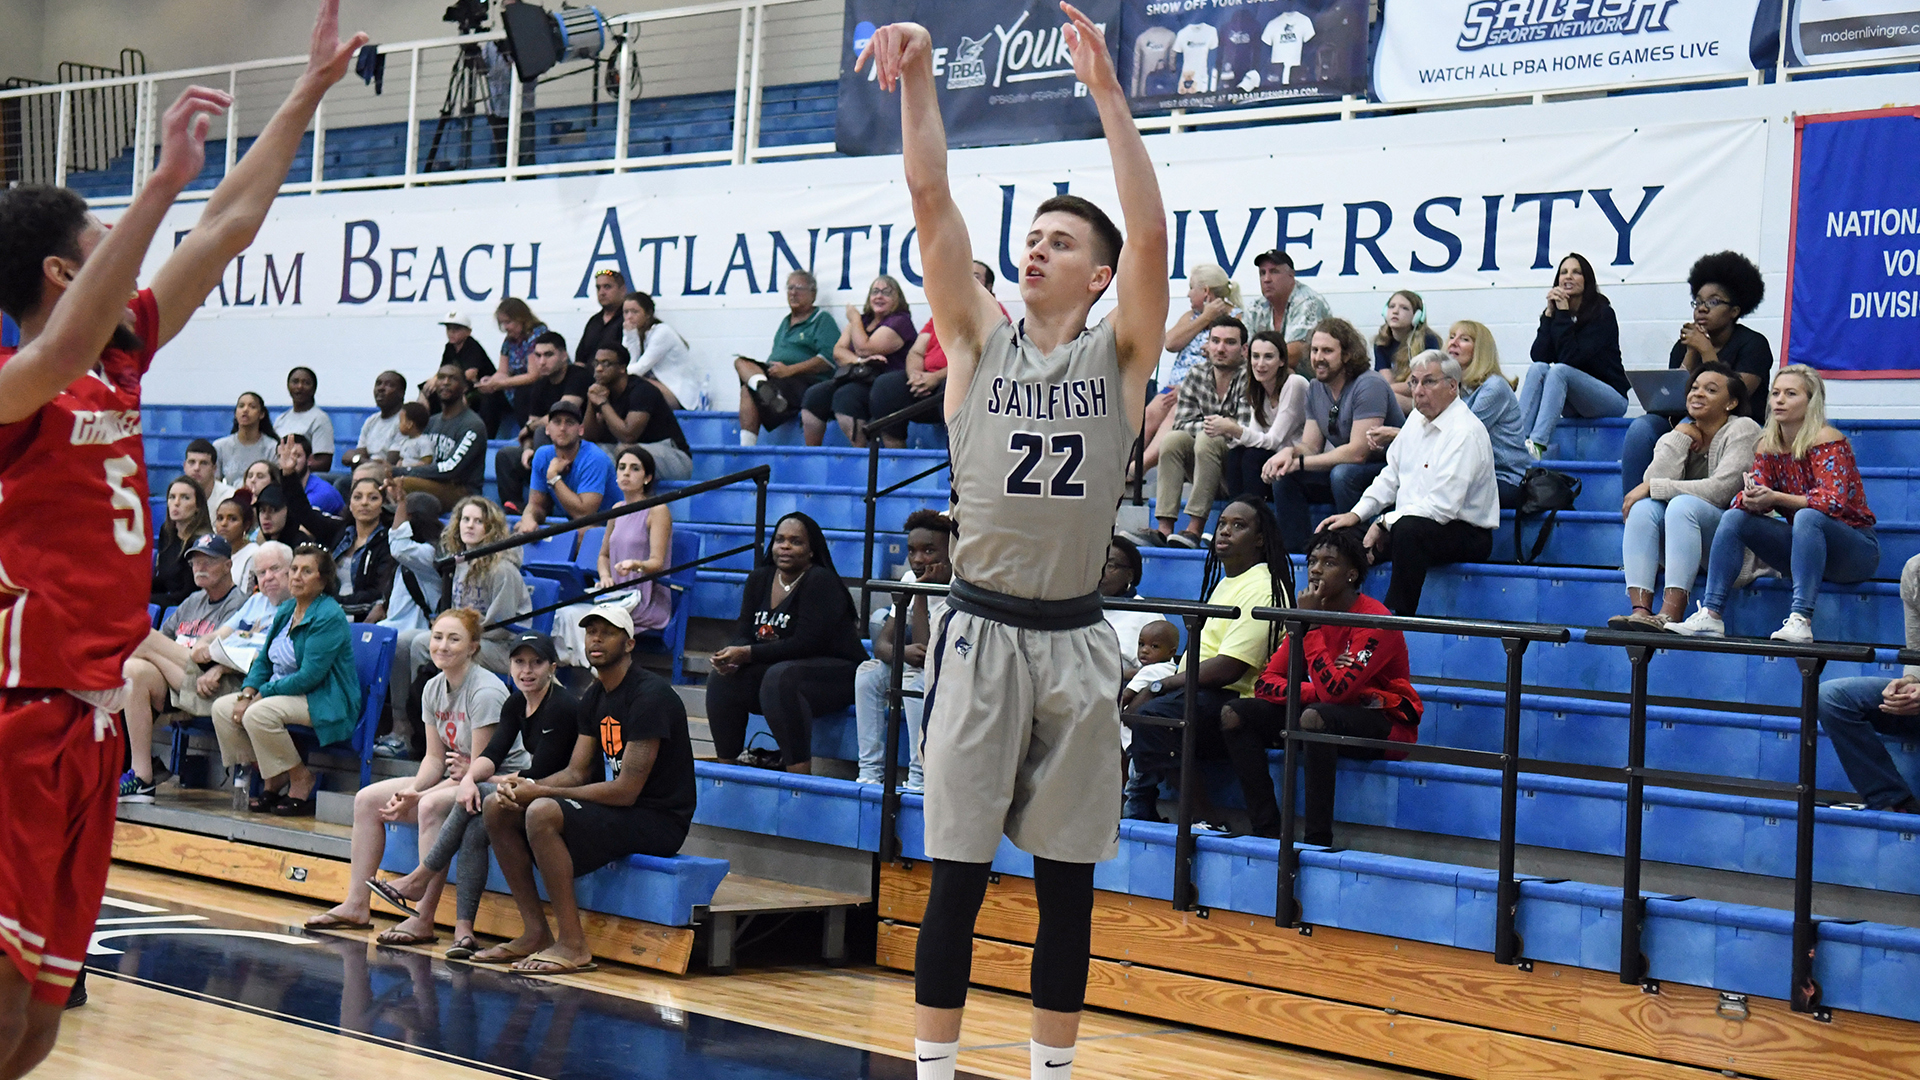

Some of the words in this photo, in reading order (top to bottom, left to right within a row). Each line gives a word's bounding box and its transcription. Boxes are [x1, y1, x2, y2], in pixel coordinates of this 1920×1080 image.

[1146, 3, 1181, 16] SHOW
[1184, 0, 1207, 11] OFF
[1487, 25, 1547, 45] SPORTS
[1549, 15, 1628, 39] NETWORK
[993, 10, 1107, 88] YOUR
[1418, 65, 1475, 84] WATCH
[1479, 62, 1508, 78] ALL
[1512, 58, 1548, 76] PBA
[1552, 52, 1604, 72] HOME
[1608, 45, 1675, 66] GAMES
[1680, 40, 1720, 59] LIVE
[951, 61, 984, 79] PBA
[1190, 96, 1216, 107] ONLINE
[1826, 207, 1920, 238] NATION
[337, 219, 541, 305] BEACH
[999, 181, 1665, 284] UIVERSITY
[1849, 290, 1920, 319] DIVISI
[988, 376, 1108, 421] SAILFISH
[1004, 430, 1087, 499] 22
[103, 454, 146, 555] 5
[754, 611, 791, 629] TEAM
